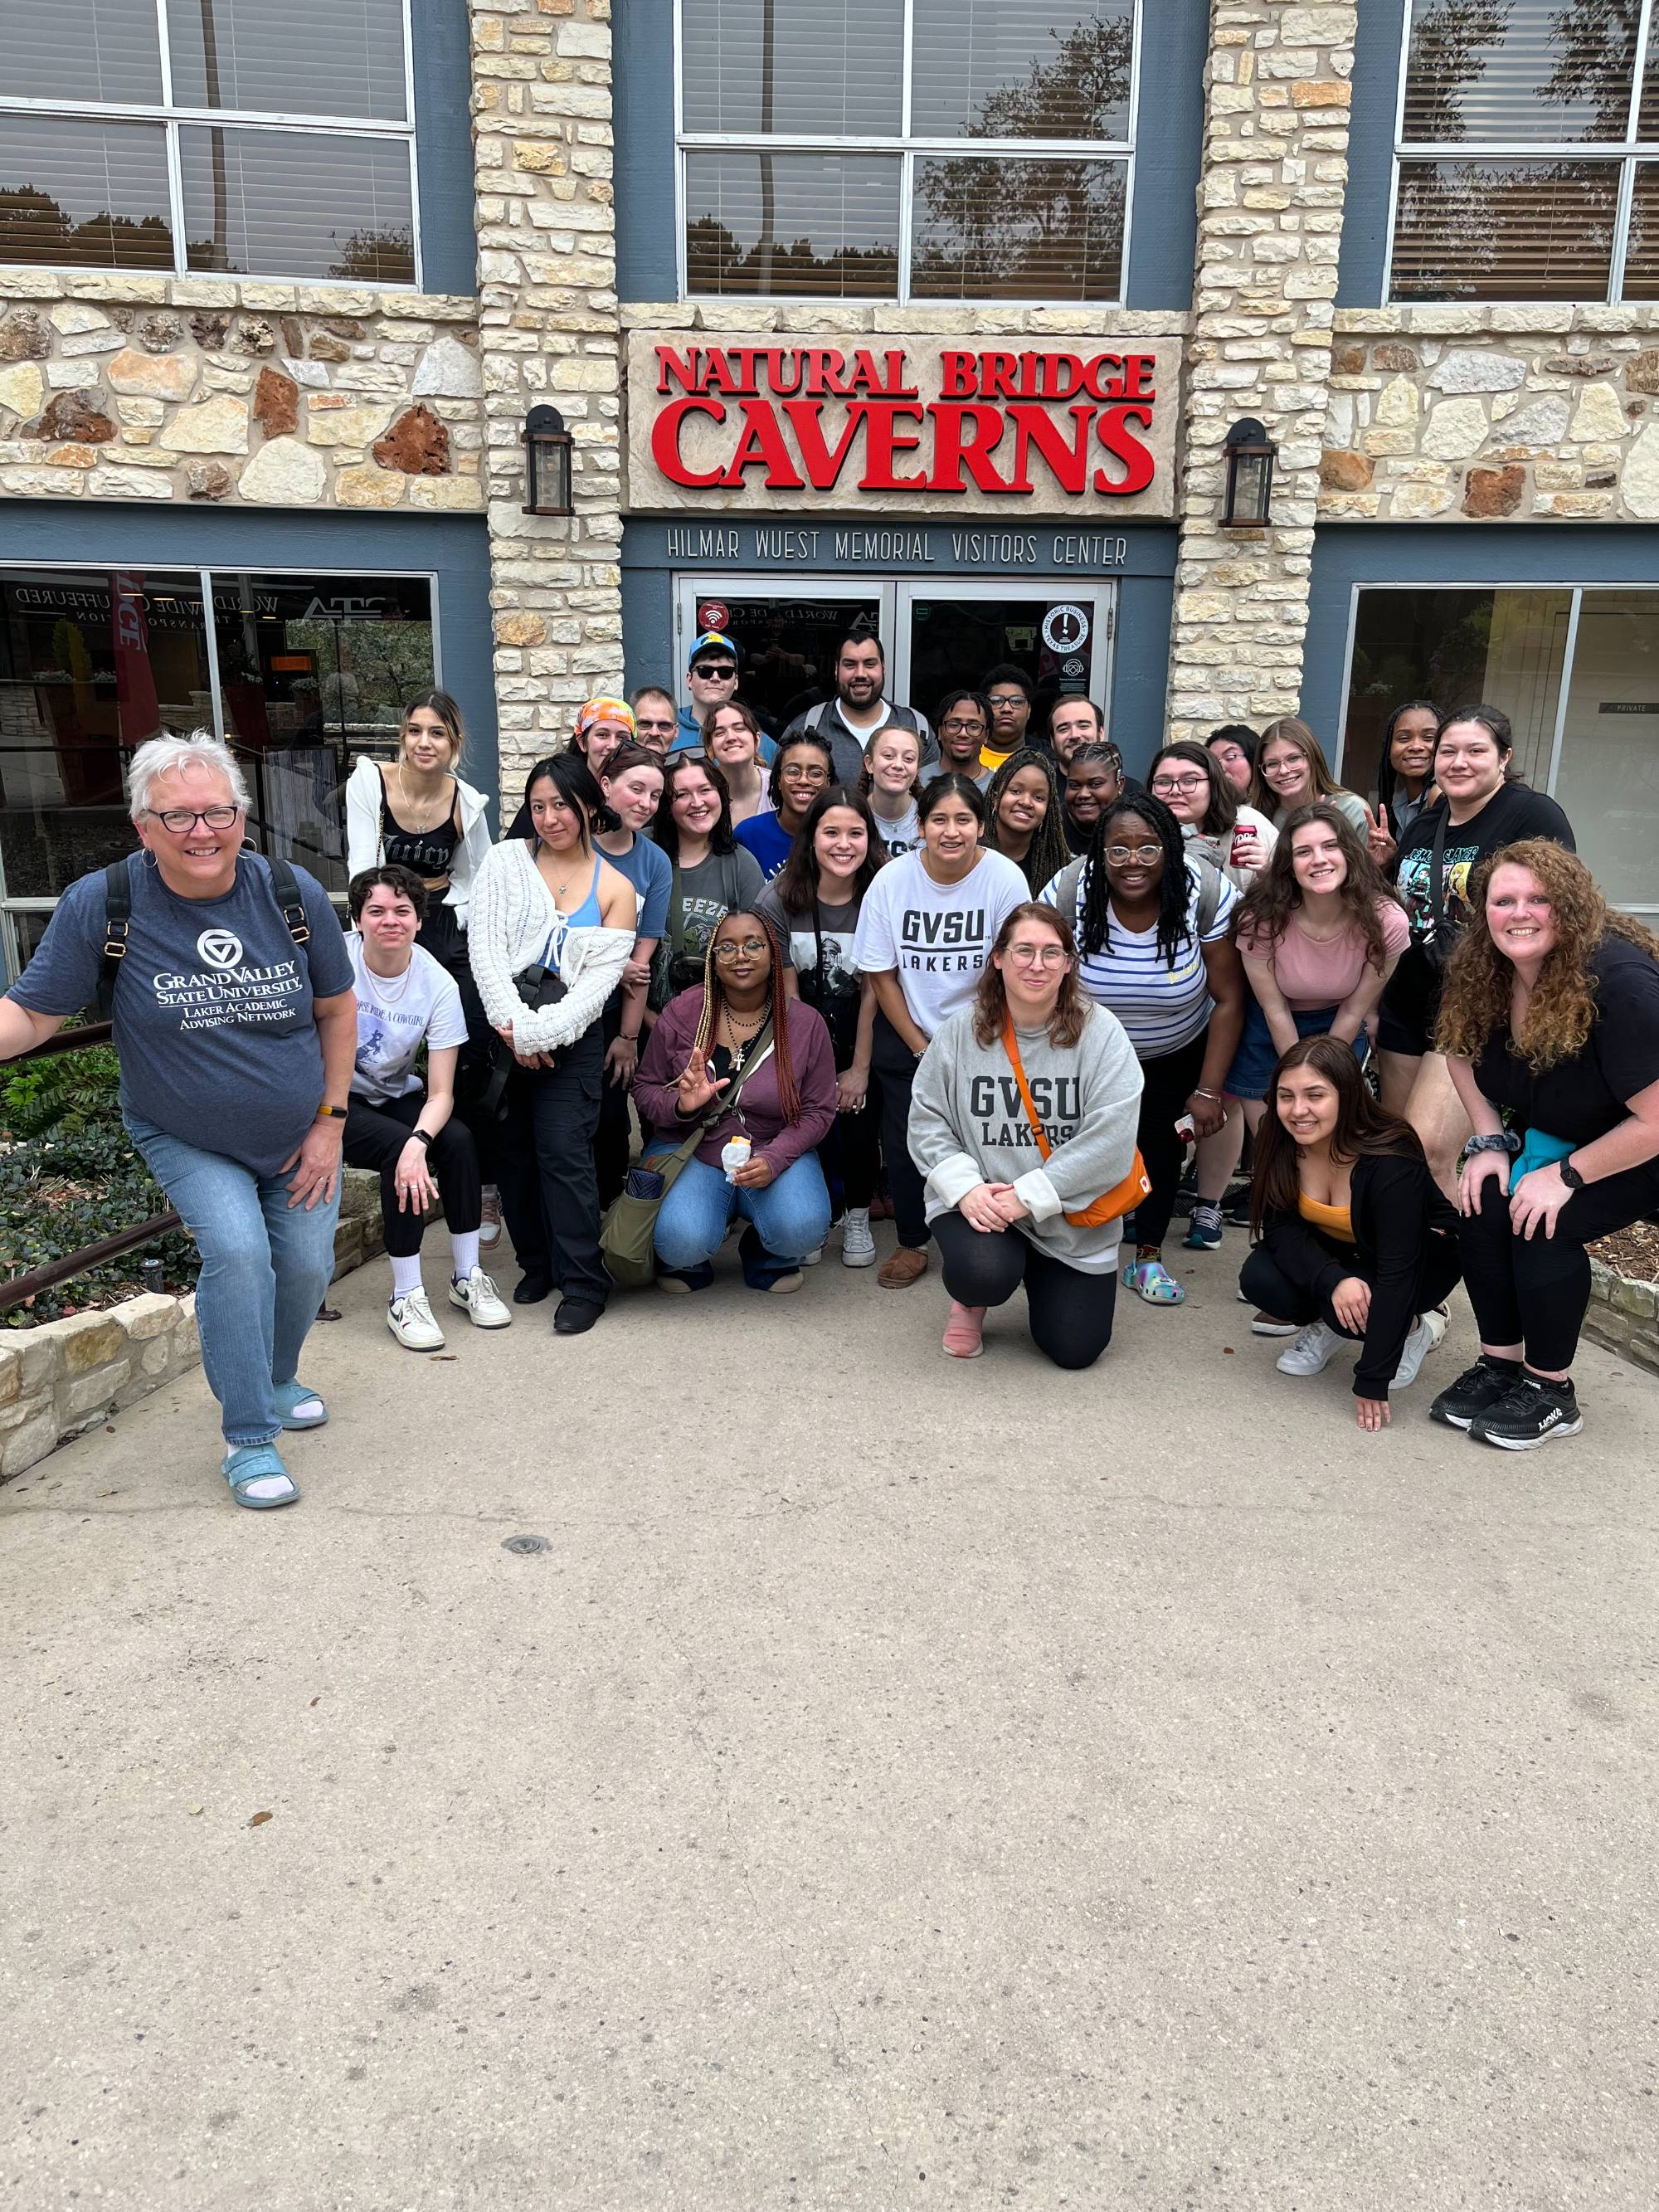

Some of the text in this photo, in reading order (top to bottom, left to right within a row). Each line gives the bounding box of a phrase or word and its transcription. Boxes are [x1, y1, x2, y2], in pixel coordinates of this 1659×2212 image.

[654, 344, 1156, 403] NATURAL BRIDGE
[651, 397, 1156, 496] CAVERNS
[667, 528, 1127, 566] HILMAR WUEST MEMORIAL VISITORS CENTER
[1045, 607, 1087, 630] HISTORIC BUSINESS
[1045, 634, 1085, 651] TEXAS TREASURE
[902, 909, 985, 944] GVSU
[153, 960, 296, 991] GRAND VALLEY
[902, 954, 984, 972] LAKERS
[156, 976, 302, 1005] STATE UNIVERSITY
[179, 1007, 296, 1030] ADVISING NETWORK
[182, 998, 288, 1019] LAKER ACADEMIC
[392, 1012, 426, 1028] COWGIRL
[971, 1075, 1081, 1120] GVSU
[981, 1122, 1074, 1148] LAKRS
